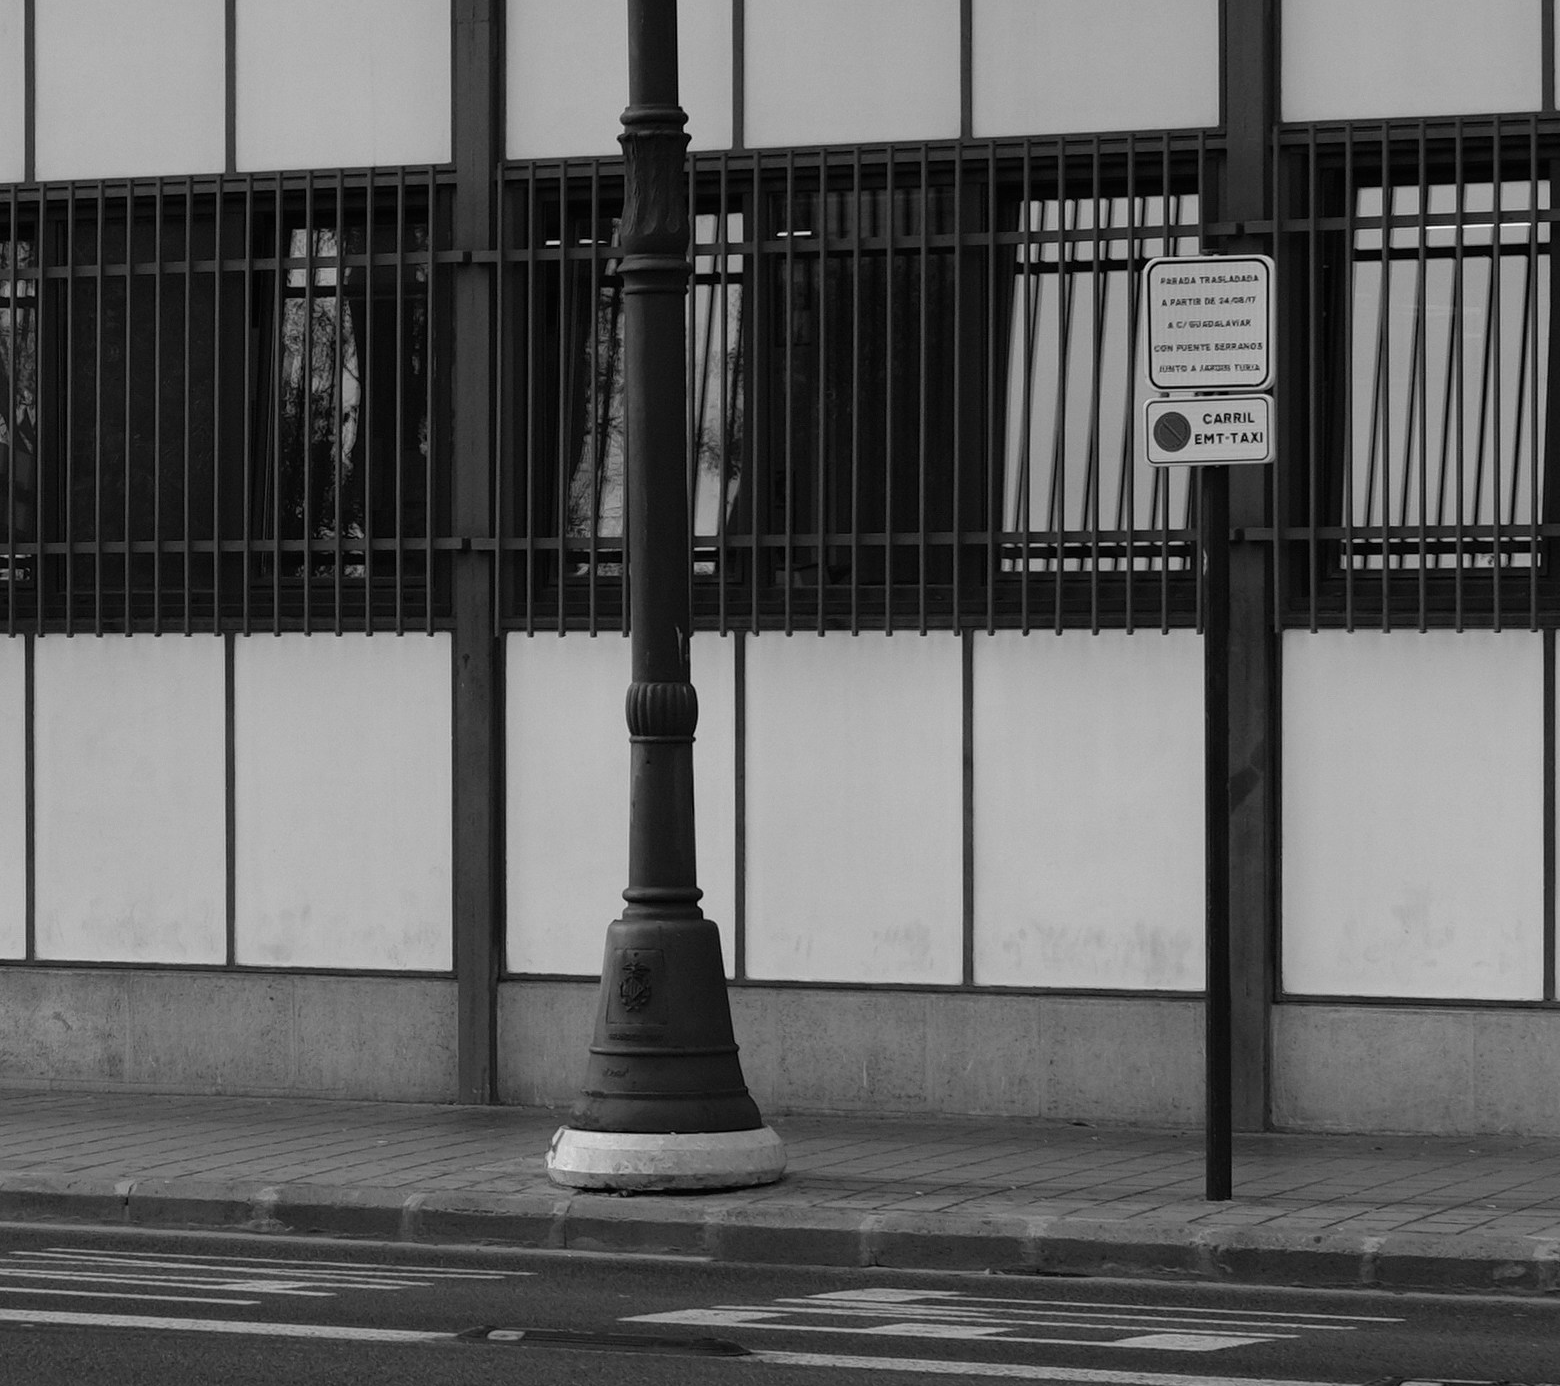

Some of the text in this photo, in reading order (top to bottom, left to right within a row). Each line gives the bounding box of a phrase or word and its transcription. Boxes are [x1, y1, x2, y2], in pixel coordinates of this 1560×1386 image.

[1160, 274, 1259, 285] PARADA TRASLADADA
[1161, 299, 1168, 307] A
[1170, 297, 1202, 307] PARTIR
[1205, 296, 1216, 305] DE
[1167, 318, 1251, 329] A C/ GUADALAVIAR
[1153, 342, 1263, 353] CON PUENTE SERRANOS
[1159, 364, 1188, 373] JUNTO
[1190, 364, 1197, 372] A
[1234, 363, 1261, 372] TURIA
[1202, 412, 1256, 425] CARRIL
[1194, 431, 1264, 445] EMT-TAXI
